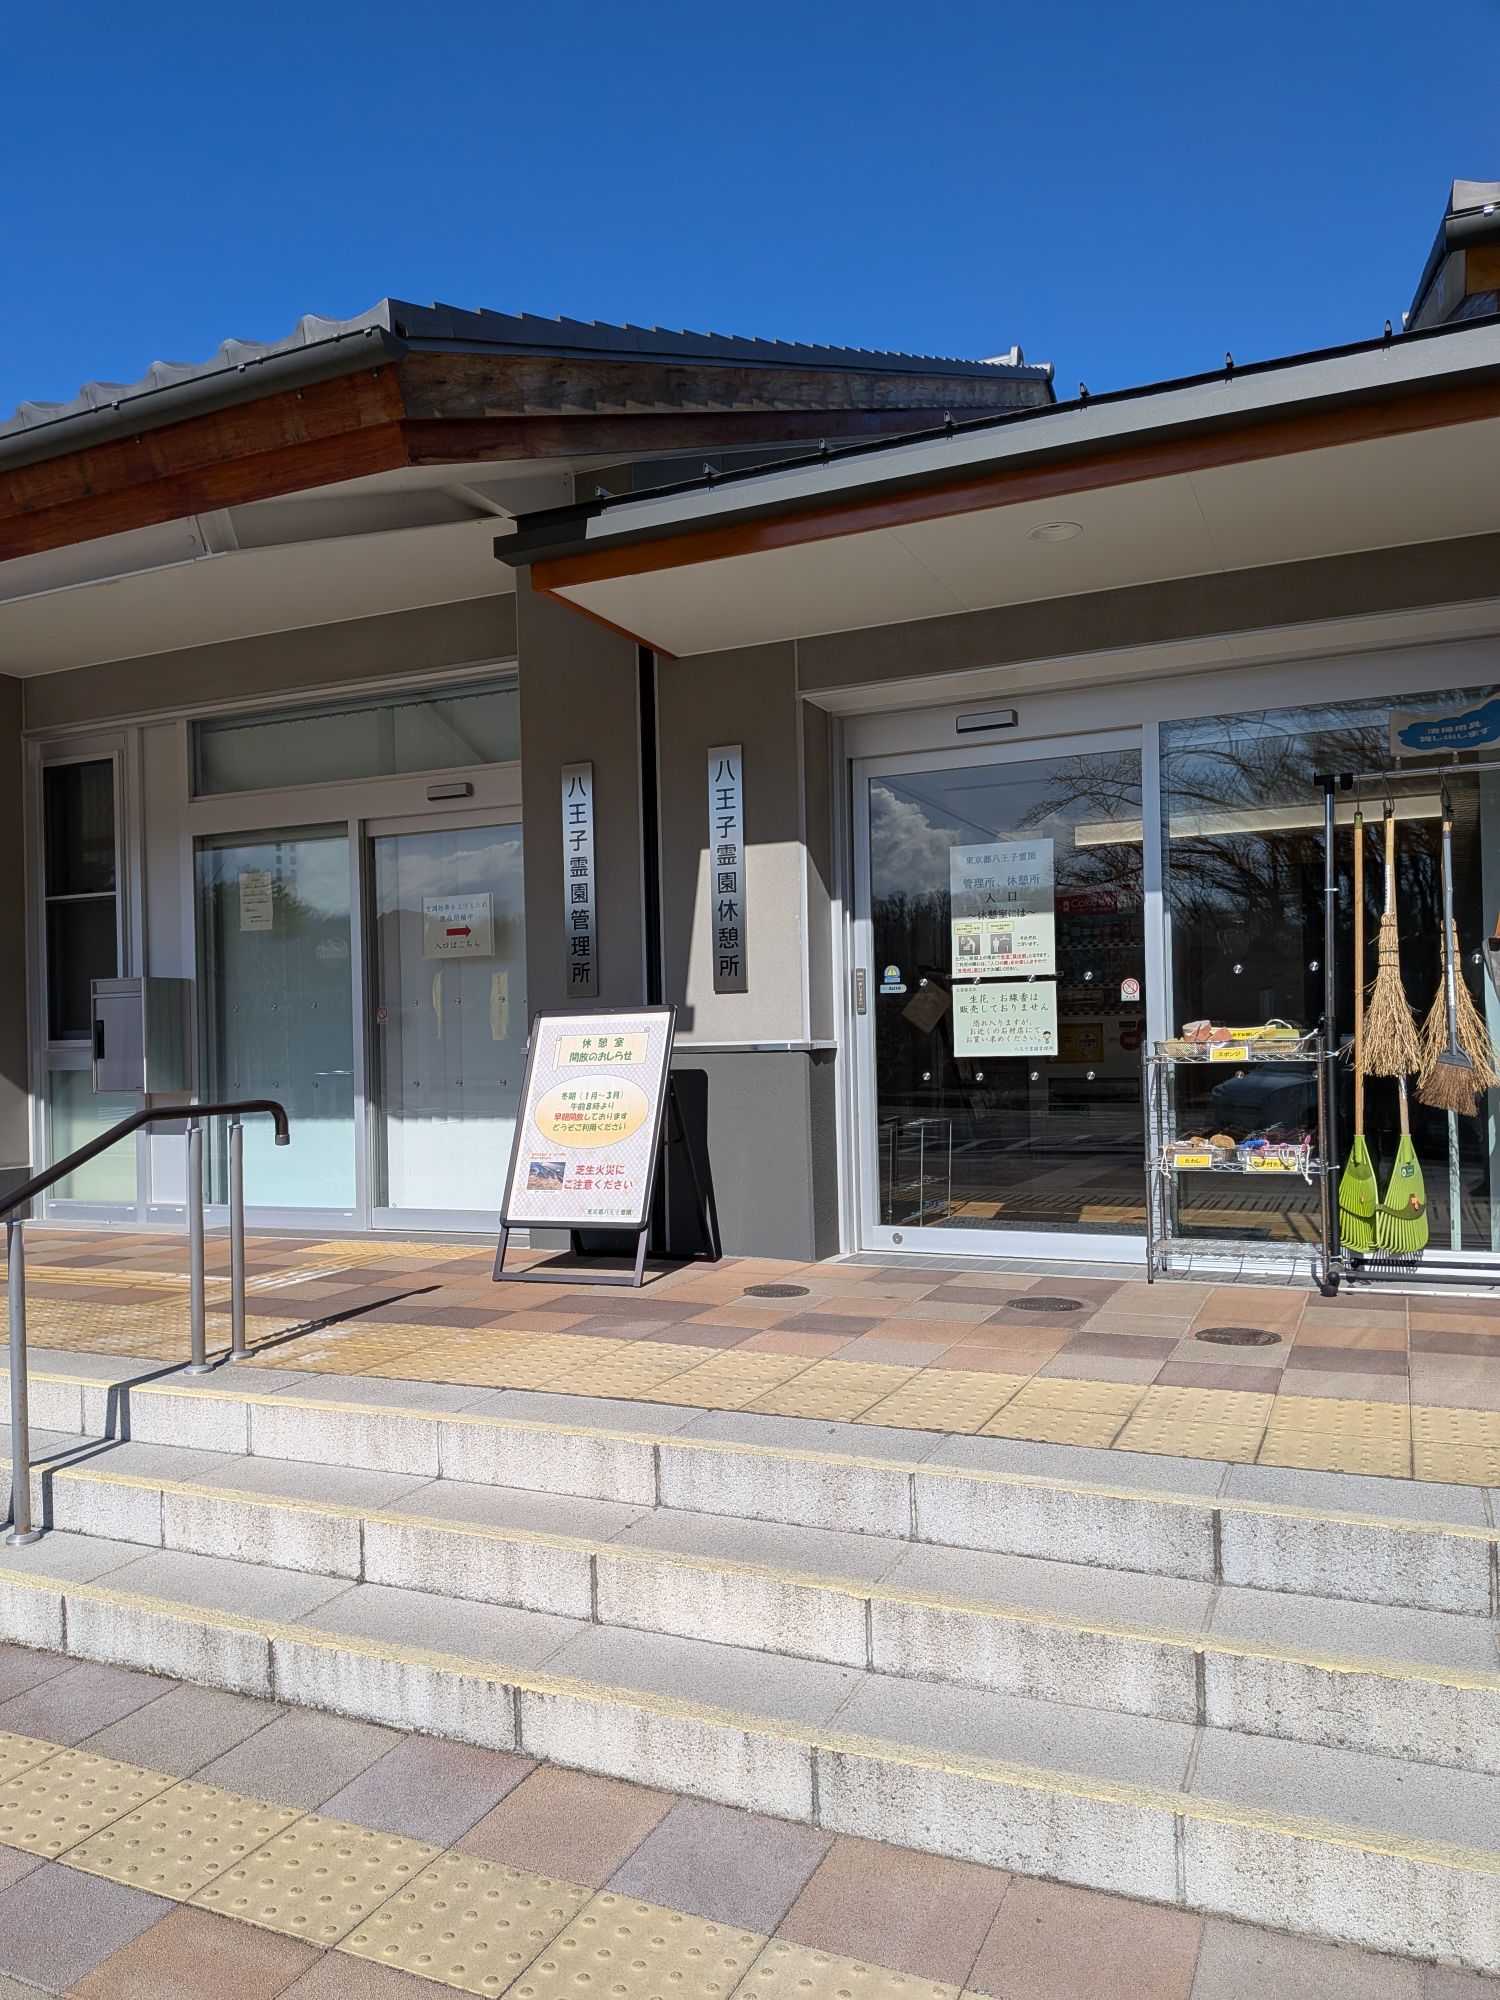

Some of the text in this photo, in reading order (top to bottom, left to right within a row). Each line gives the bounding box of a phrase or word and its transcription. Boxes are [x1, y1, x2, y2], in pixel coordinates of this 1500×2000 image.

[966, 852, 1036, 865] 東京都八王子霊園
[715, 760, 739, 976] 八王子霊園休憩所
[568, 777, 591, 983] 八王子霊園管理所
[434, 940, 481, 950] 入口はこちら
[970, 993, 1039, 1004] 生花・お線香は
[960, 1002, 1050, 1014] 販売しておりません
[970, 1026, 1040, 1036] お近くの石材店にて
[966, 1034, 1042, 1044] お買い求めください。
[569, 1051, 632, 1062] 開放のおしらせ
[570, 1102, 615, 1111] 午前8時より
[554, 1112, 628, 1121] 早朝開放しております
[552, 1123, 627, 1131] どうぞご利用ください
[575, 1164, 625, 1175] 芝生火災に
[564, 1179, 633, 1190] ご注意ください
